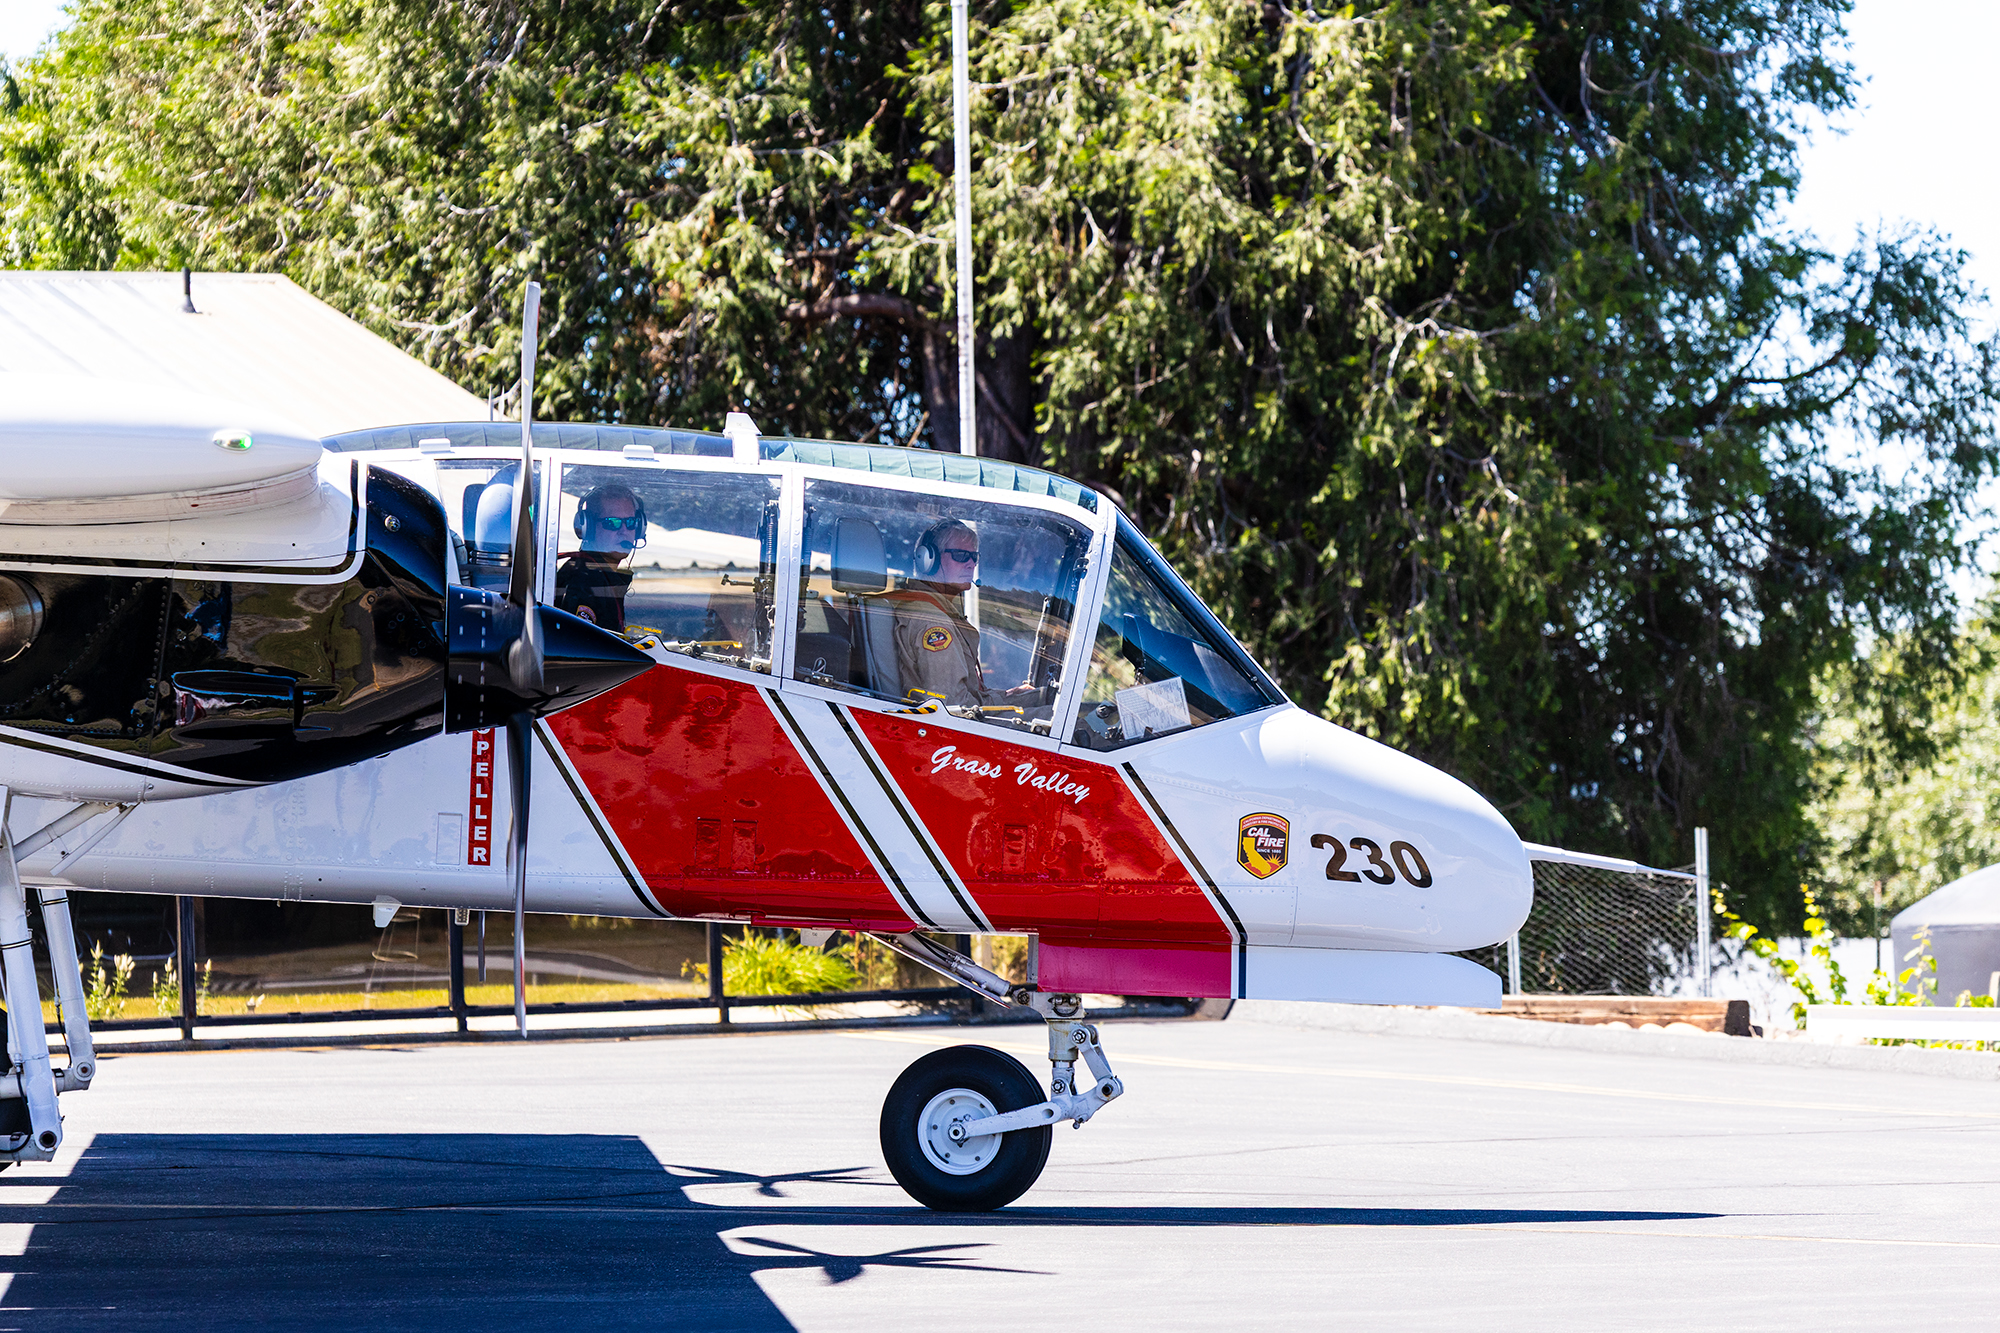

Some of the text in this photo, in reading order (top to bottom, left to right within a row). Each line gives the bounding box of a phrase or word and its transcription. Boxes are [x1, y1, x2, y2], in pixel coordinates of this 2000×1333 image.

[927, 691, 946, 699] UNLOCK
[930, 745, 1090, 804] Grass Valley
[1247, 827, 1271, 837] CAL
[1256, 837, 1286, 848] FIRE
[1310, 833, 1433, 888] 230
